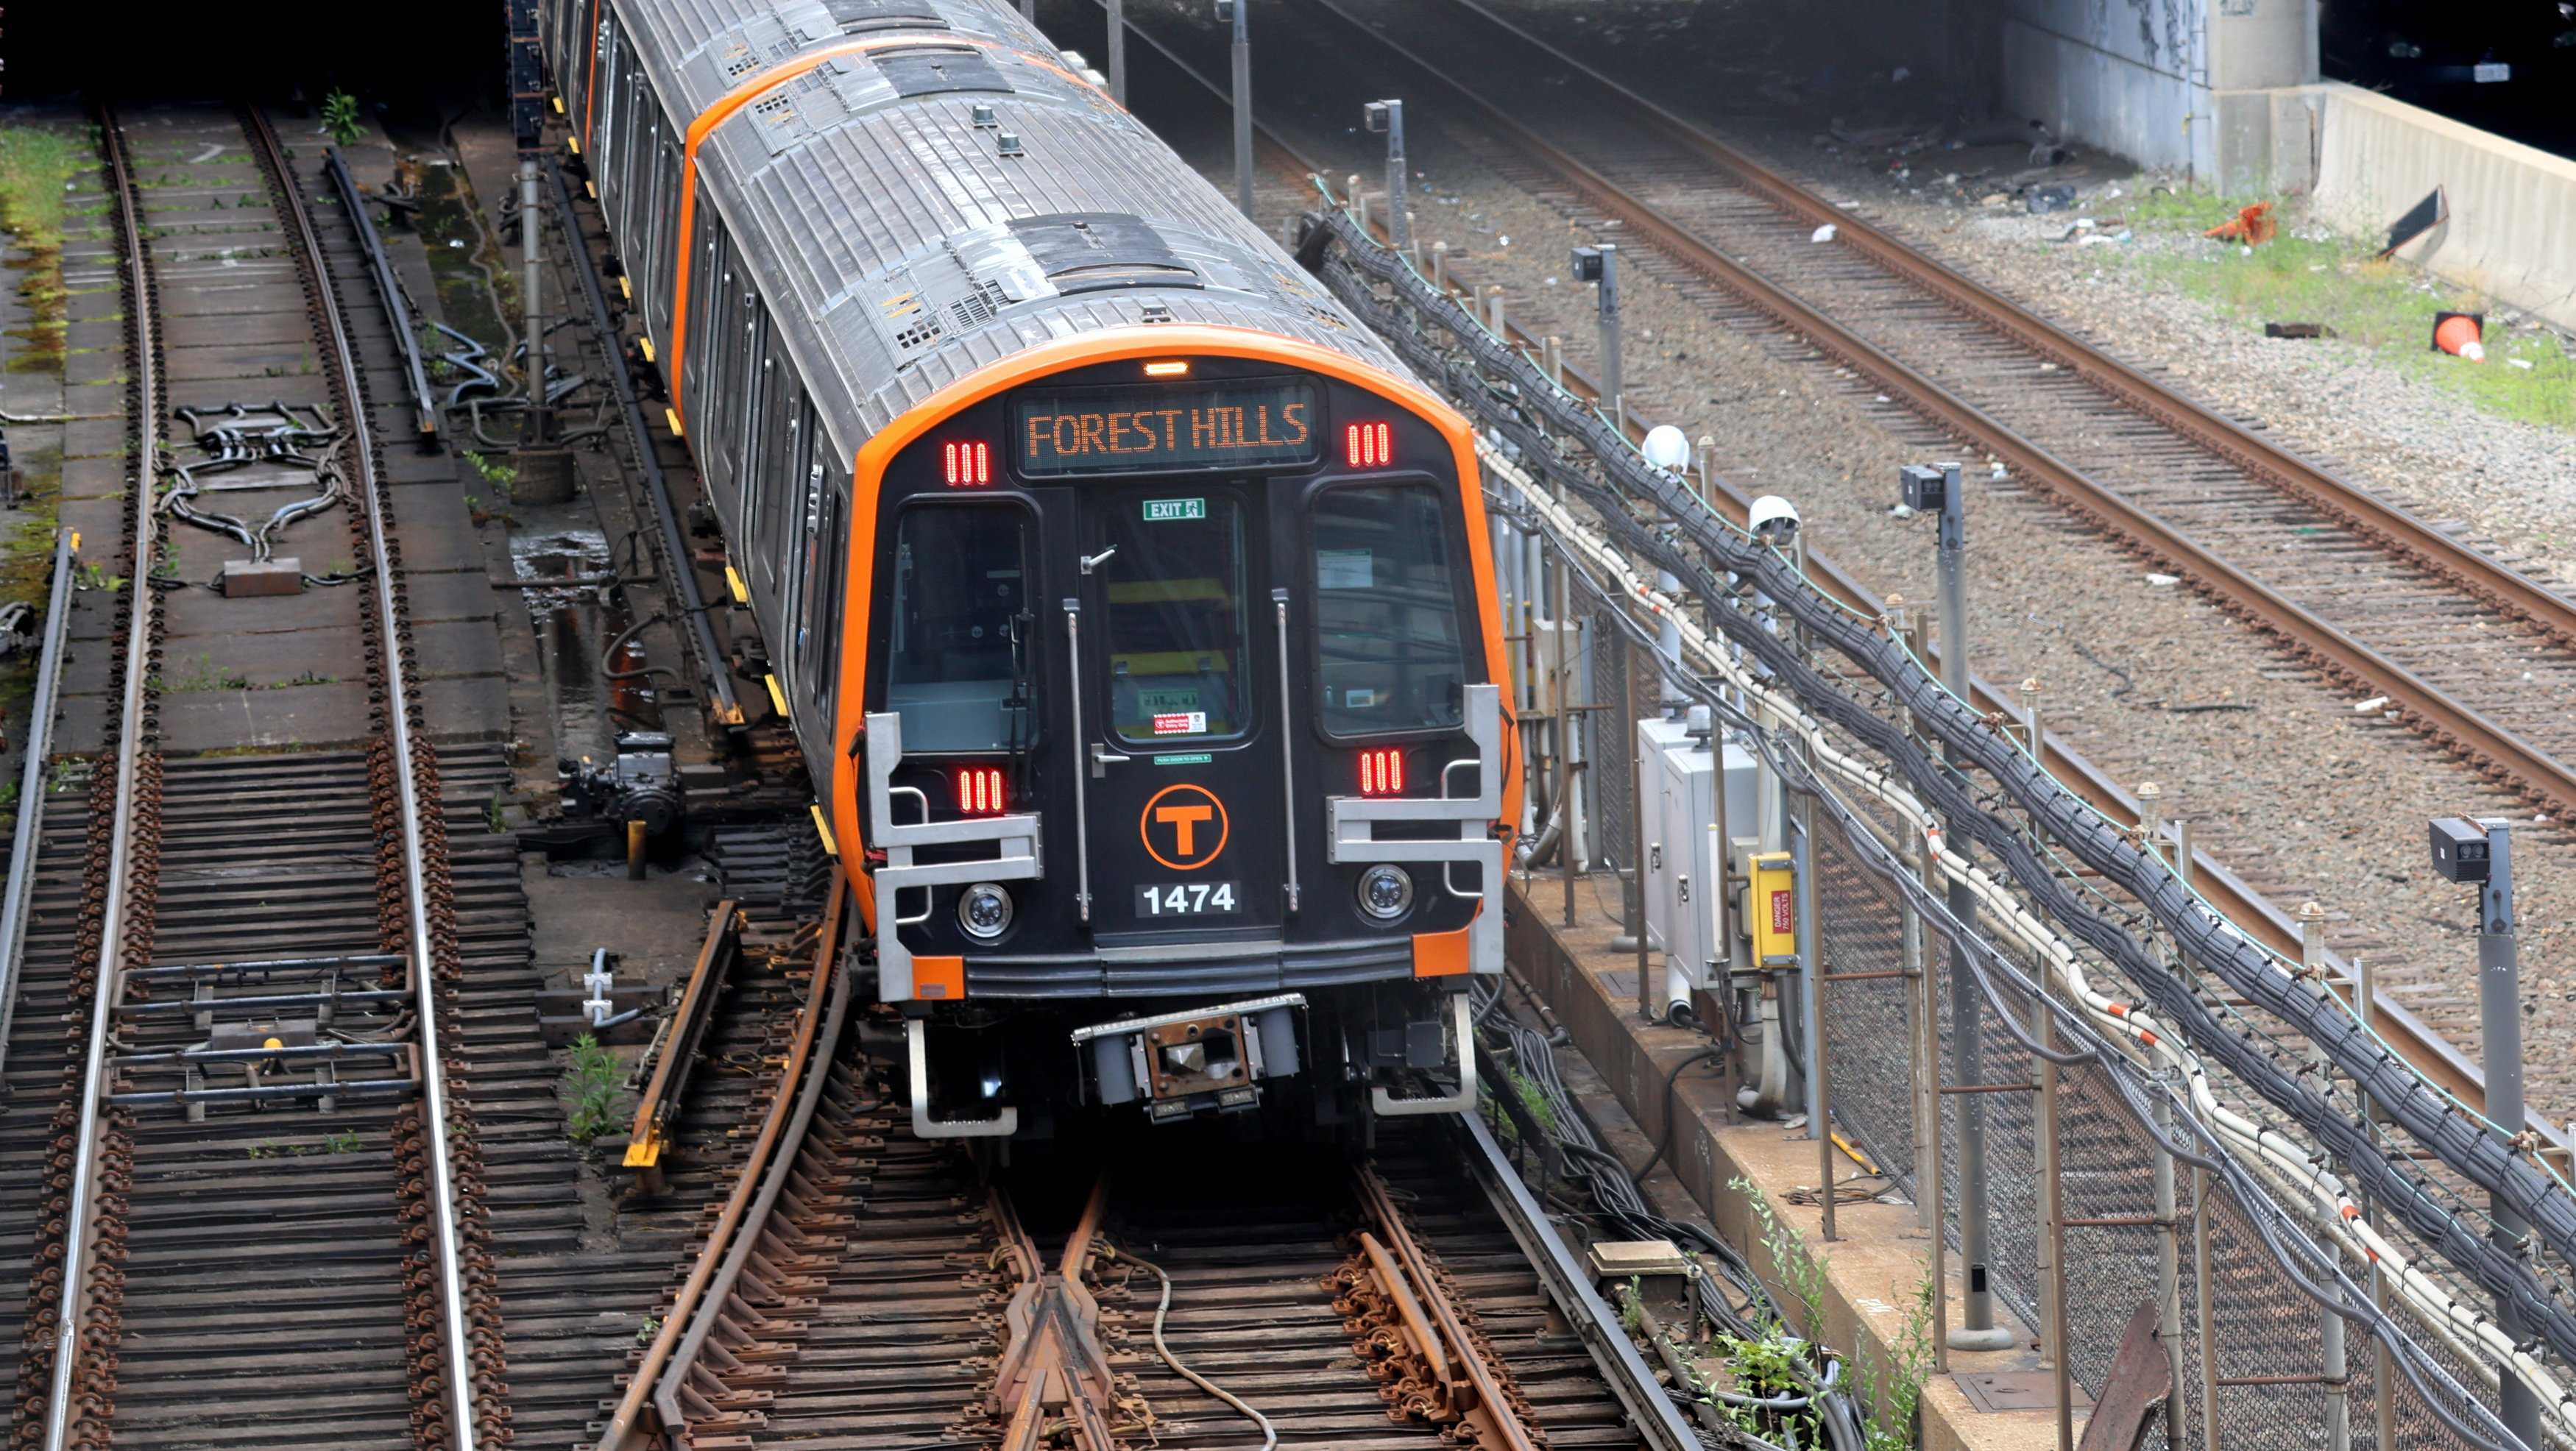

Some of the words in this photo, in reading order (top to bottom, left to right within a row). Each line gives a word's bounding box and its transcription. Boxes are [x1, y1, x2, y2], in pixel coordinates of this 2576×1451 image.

[1028, 409, 1183, 457] FOREST
[1192, 403, 1308, 449] HILLS
[1151, 503, 1181, 517] EXIT
[1156, 805, 1212, 855] T
[1143, 883, 1236, 914] 1474
[1781, 893, 1789, 917] VOLTS
